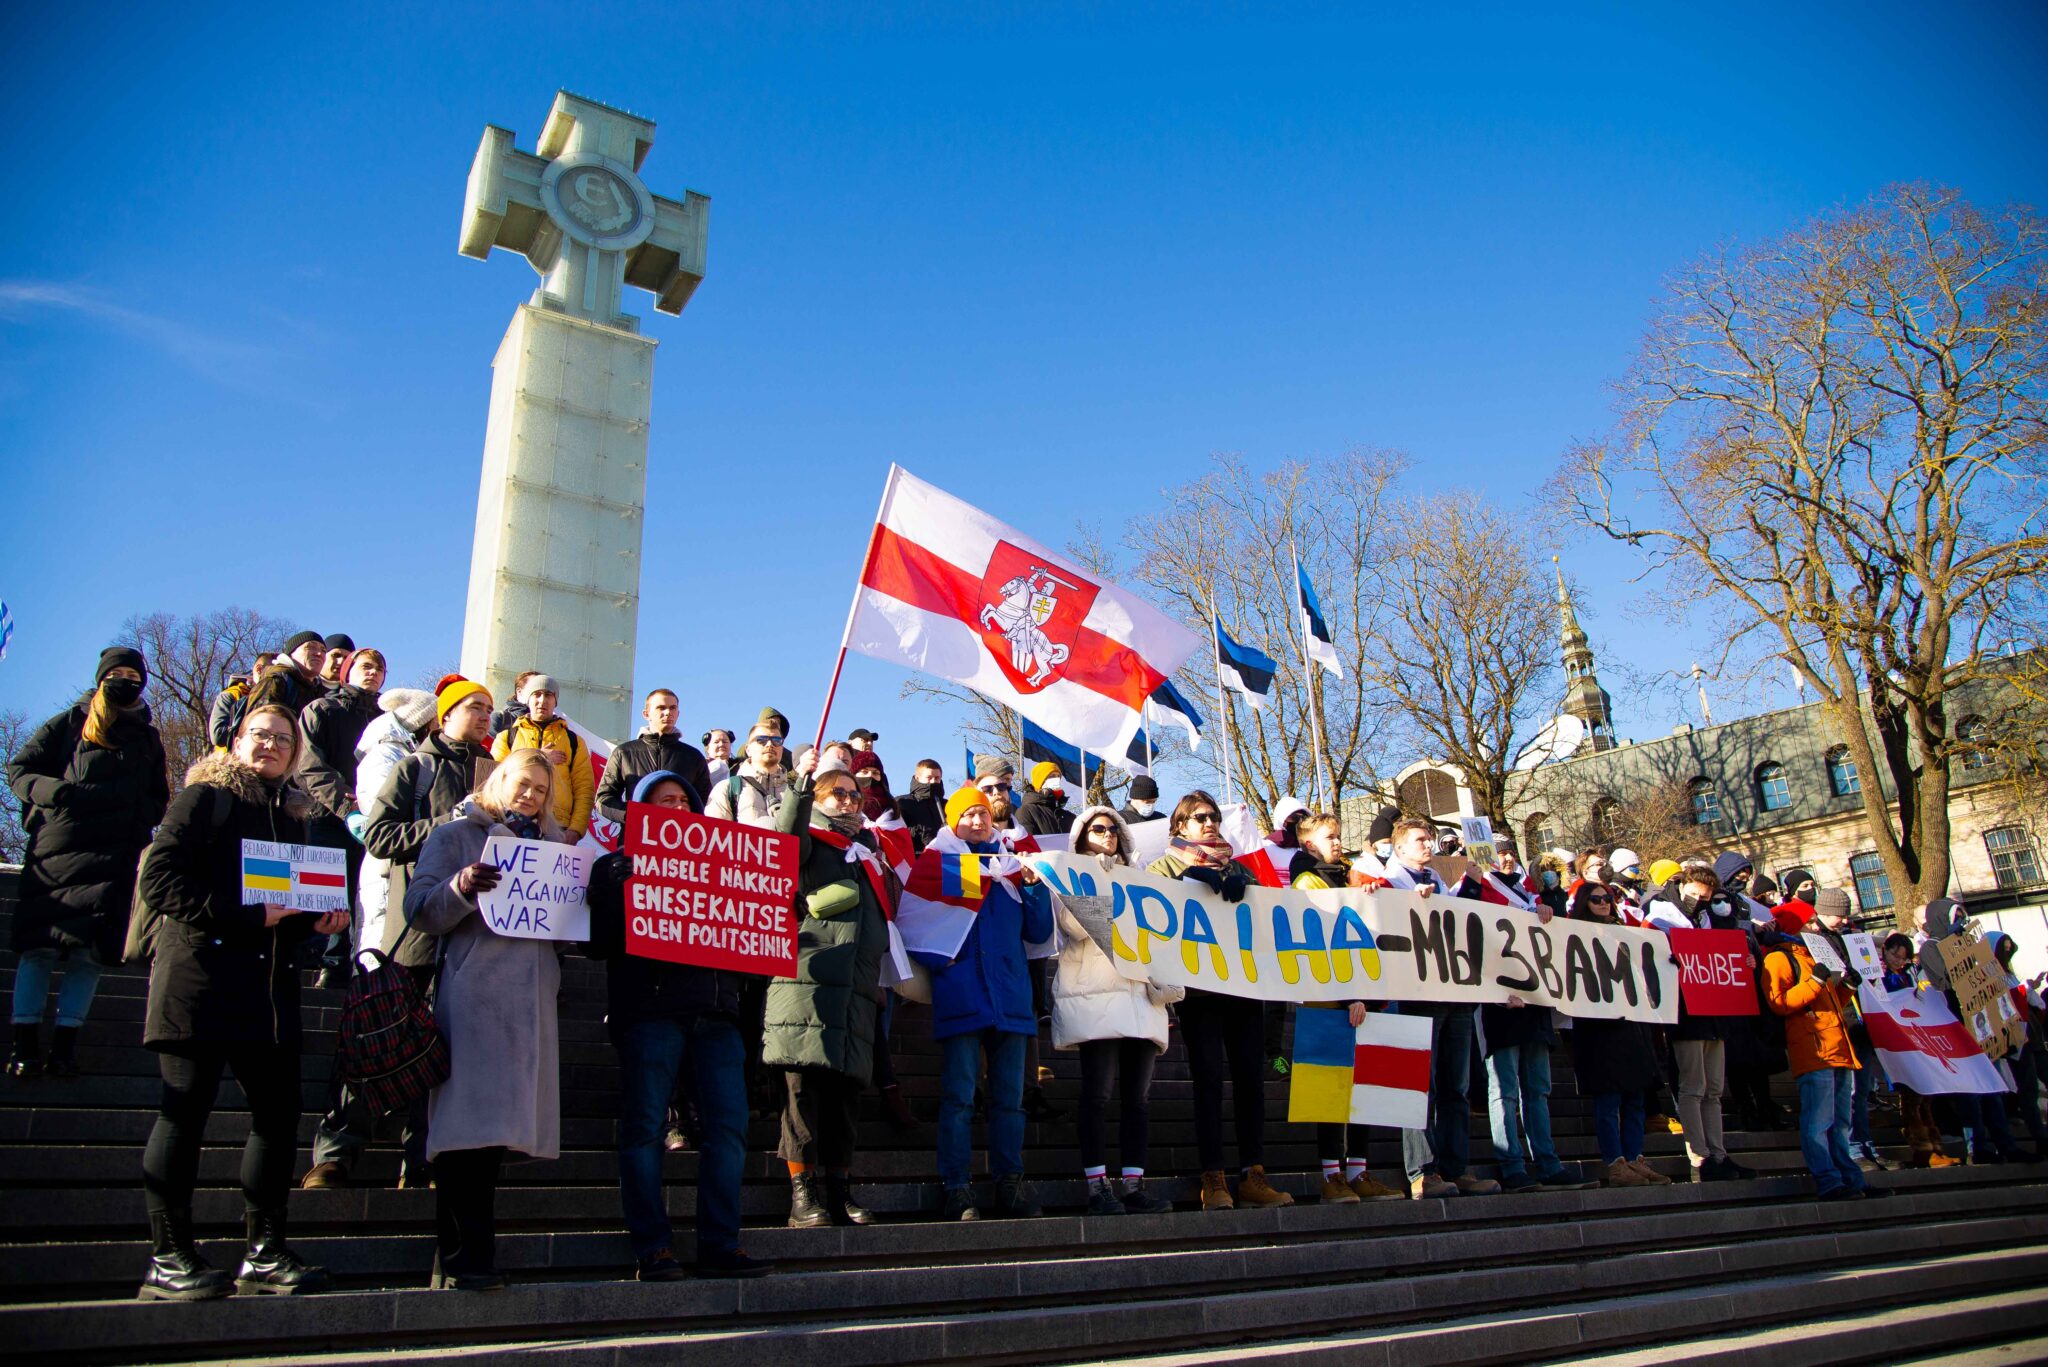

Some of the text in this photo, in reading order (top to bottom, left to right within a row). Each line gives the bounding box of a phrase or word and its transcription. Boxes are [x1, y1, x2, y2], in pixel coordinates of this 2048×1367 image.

[641, 815, 780, 870] LOOMINE
[1467, 821, 1485, 841] NO
[243, 840, 274, 857] BELARUS
[278, 842, 290, 859] IS
[290, 845, 305, 862] NOT
[493, 843, 582, 878] WE ARE
[1469, 845, 1495, 865] WAR
[507, 877, 587, 906] AGAINST
[632, 853, 793, 899] NAISELE NÄKKU?
[491, 903, 551, 933] WAR
[632, 883, 789, 932] ENESEKAITSE
[632, 916, 793, 960] OLEN POLITSEINIK
[1682, 952, 1747, 988] ЖЫВЕ
[1860, 966, 1872, 976] NOT
